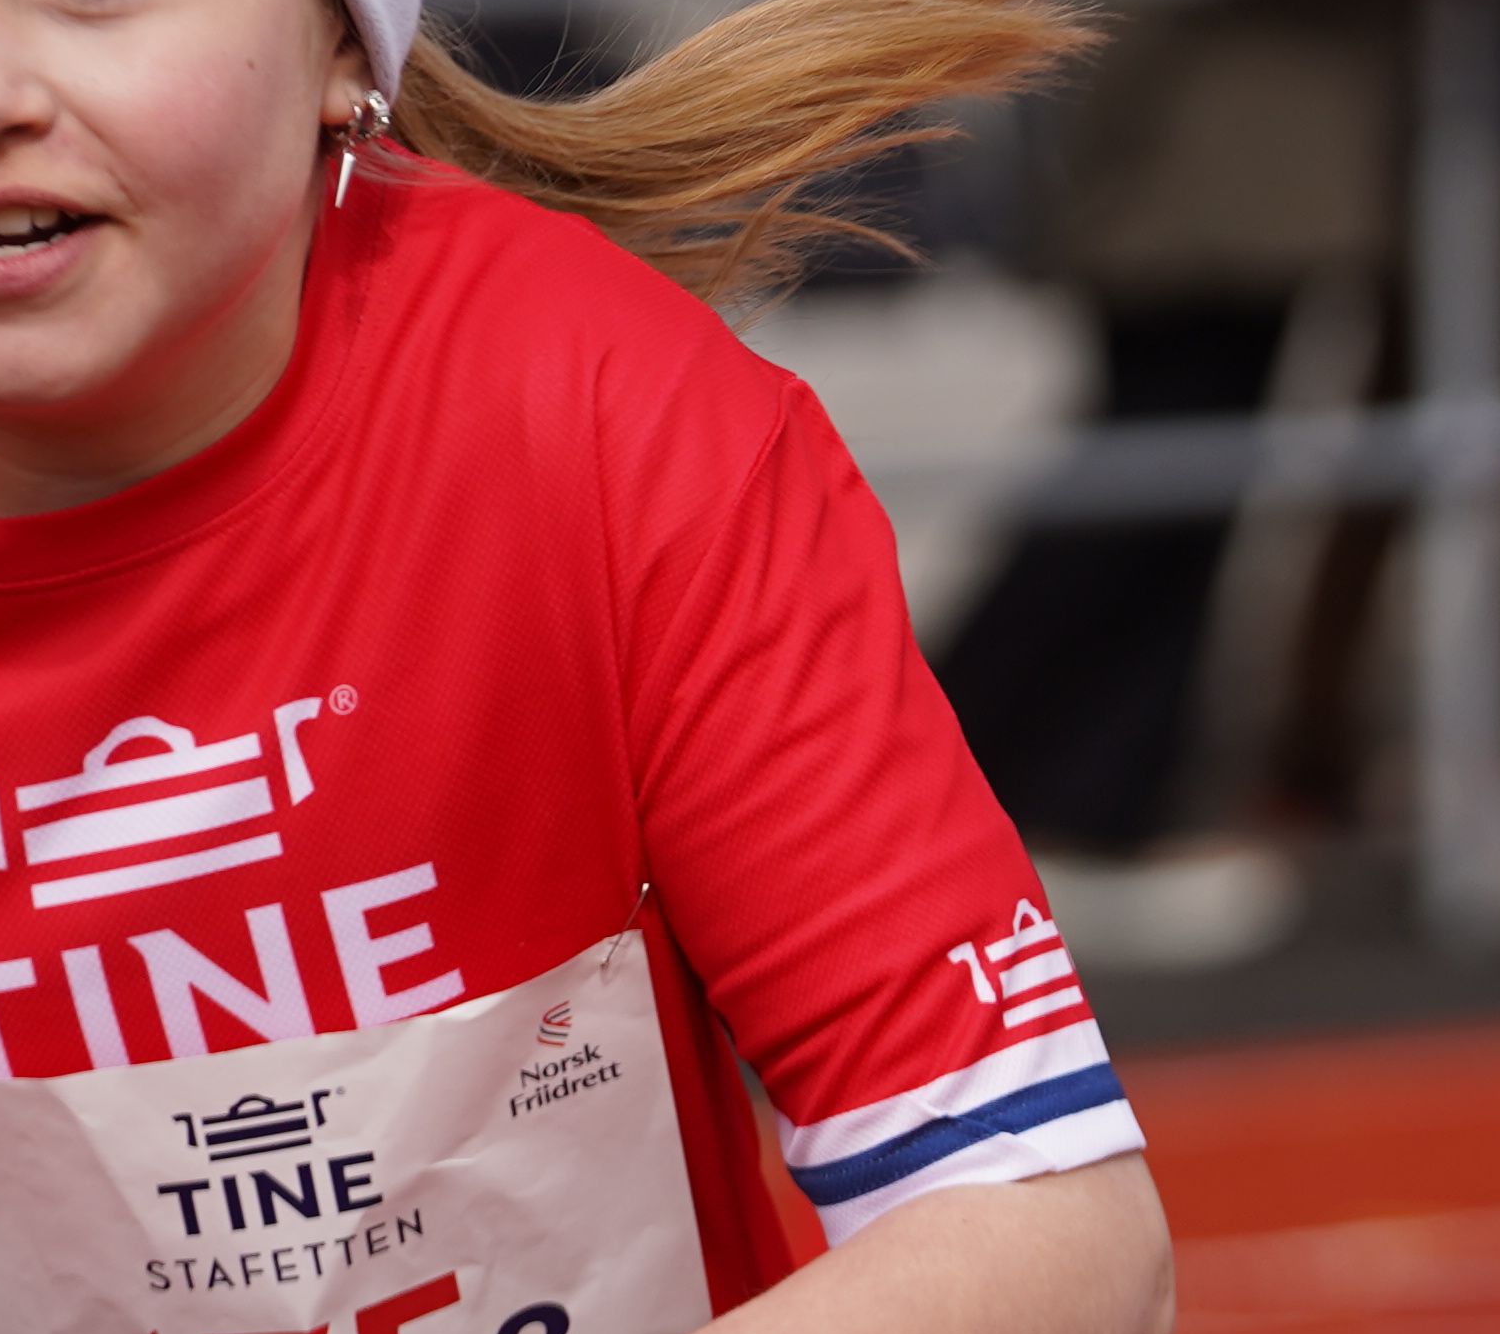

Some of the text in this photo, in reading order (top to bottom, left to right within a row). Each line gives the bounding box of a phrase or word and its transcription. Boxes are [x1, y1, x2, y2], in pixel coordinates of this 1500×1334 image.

[510, 1062, 621, 1117] Friidrett
[520, 1042, 602, 1089] Norsk
[157, 1151, 383, 1235] TINE
[146, 1208, 423, 1291] STAFETTEN
